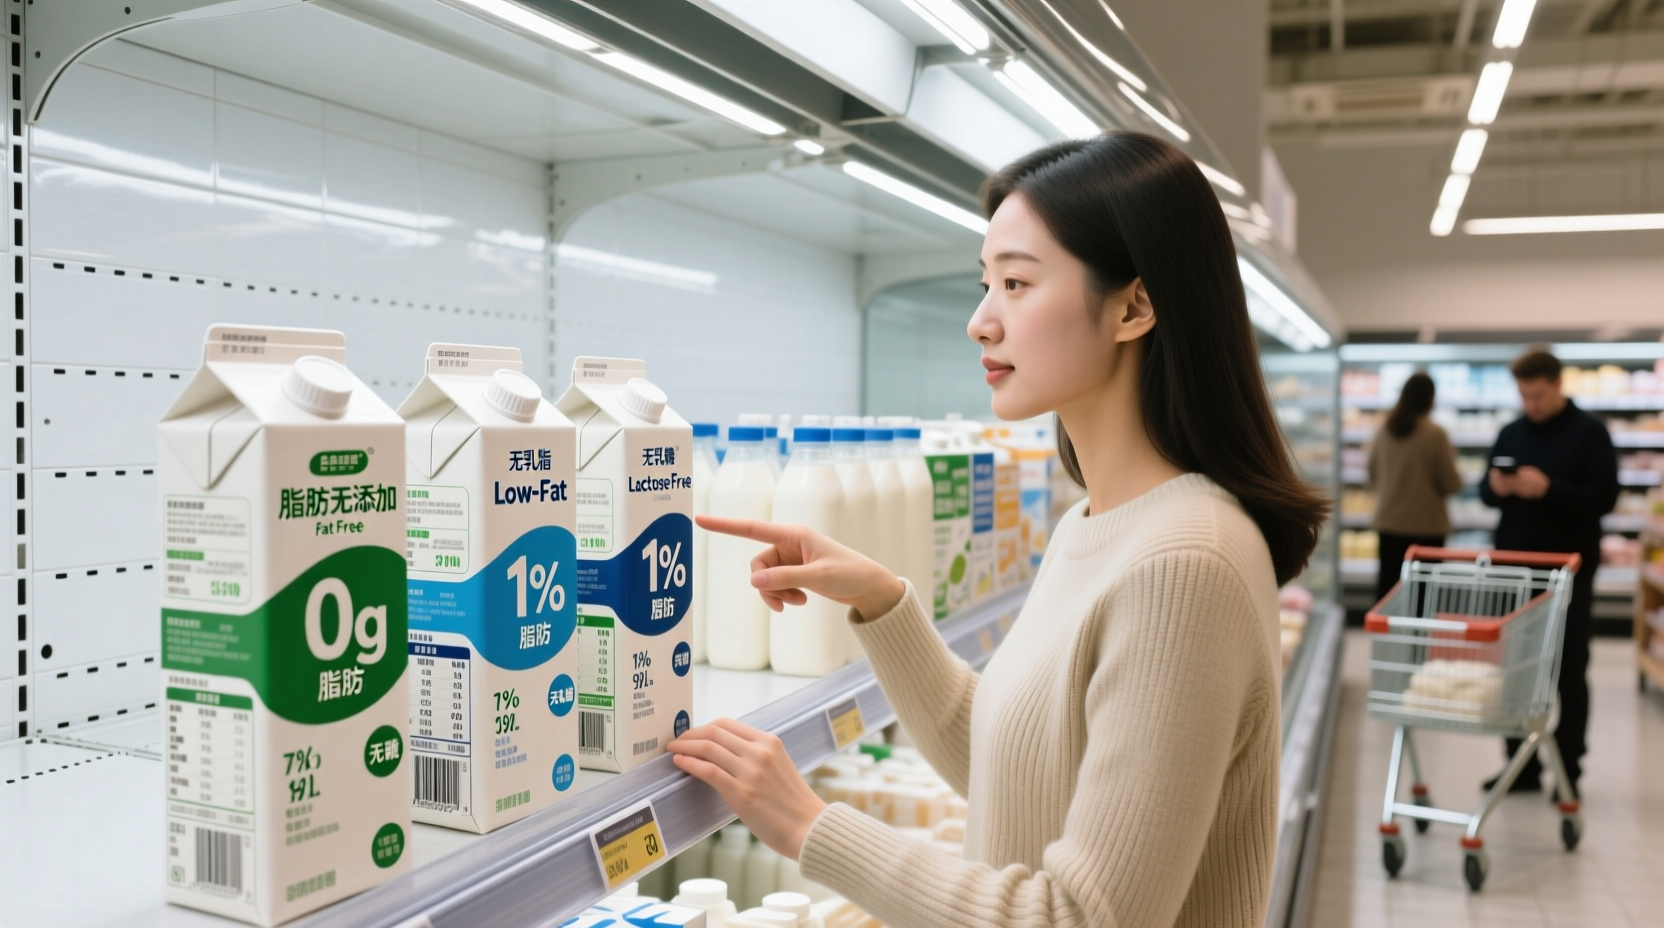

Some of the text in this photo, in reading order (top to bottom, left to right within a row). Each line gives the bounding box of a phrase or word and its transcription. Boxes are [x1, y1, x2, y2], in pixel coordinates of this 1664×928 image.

[279, 483, 396, 520] 脂肪无添加
[494, 479, 567, 505] Low-Fat
[316, 520, 364, 536] Fat Free
[642, 539, 686, 592] 1%
[507, 555, 565, 618] 1%
[305, 577, 387, 665] 0g
[318, 665, 364, 702] 脂肪
